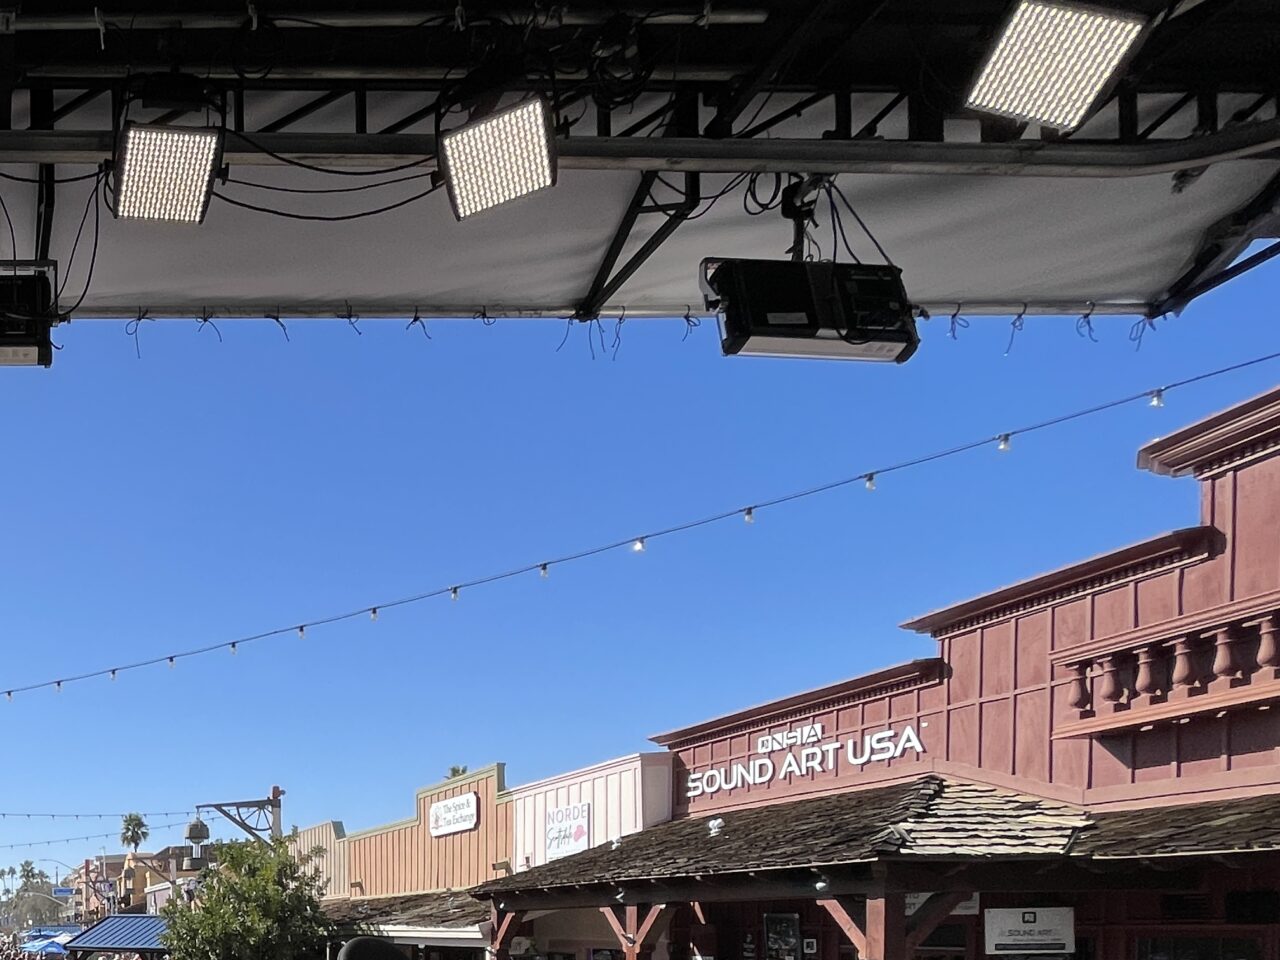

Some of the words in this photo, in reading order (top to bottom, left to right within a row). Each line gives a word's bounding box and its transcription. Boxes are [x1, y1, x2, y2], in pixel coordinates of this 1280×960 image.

[686, 758, 774, 797] SOUND
[778, 742, 841, 779] ART
[847, 725, 924, 766] USA
[547, 804, 587, 825] NORDE
